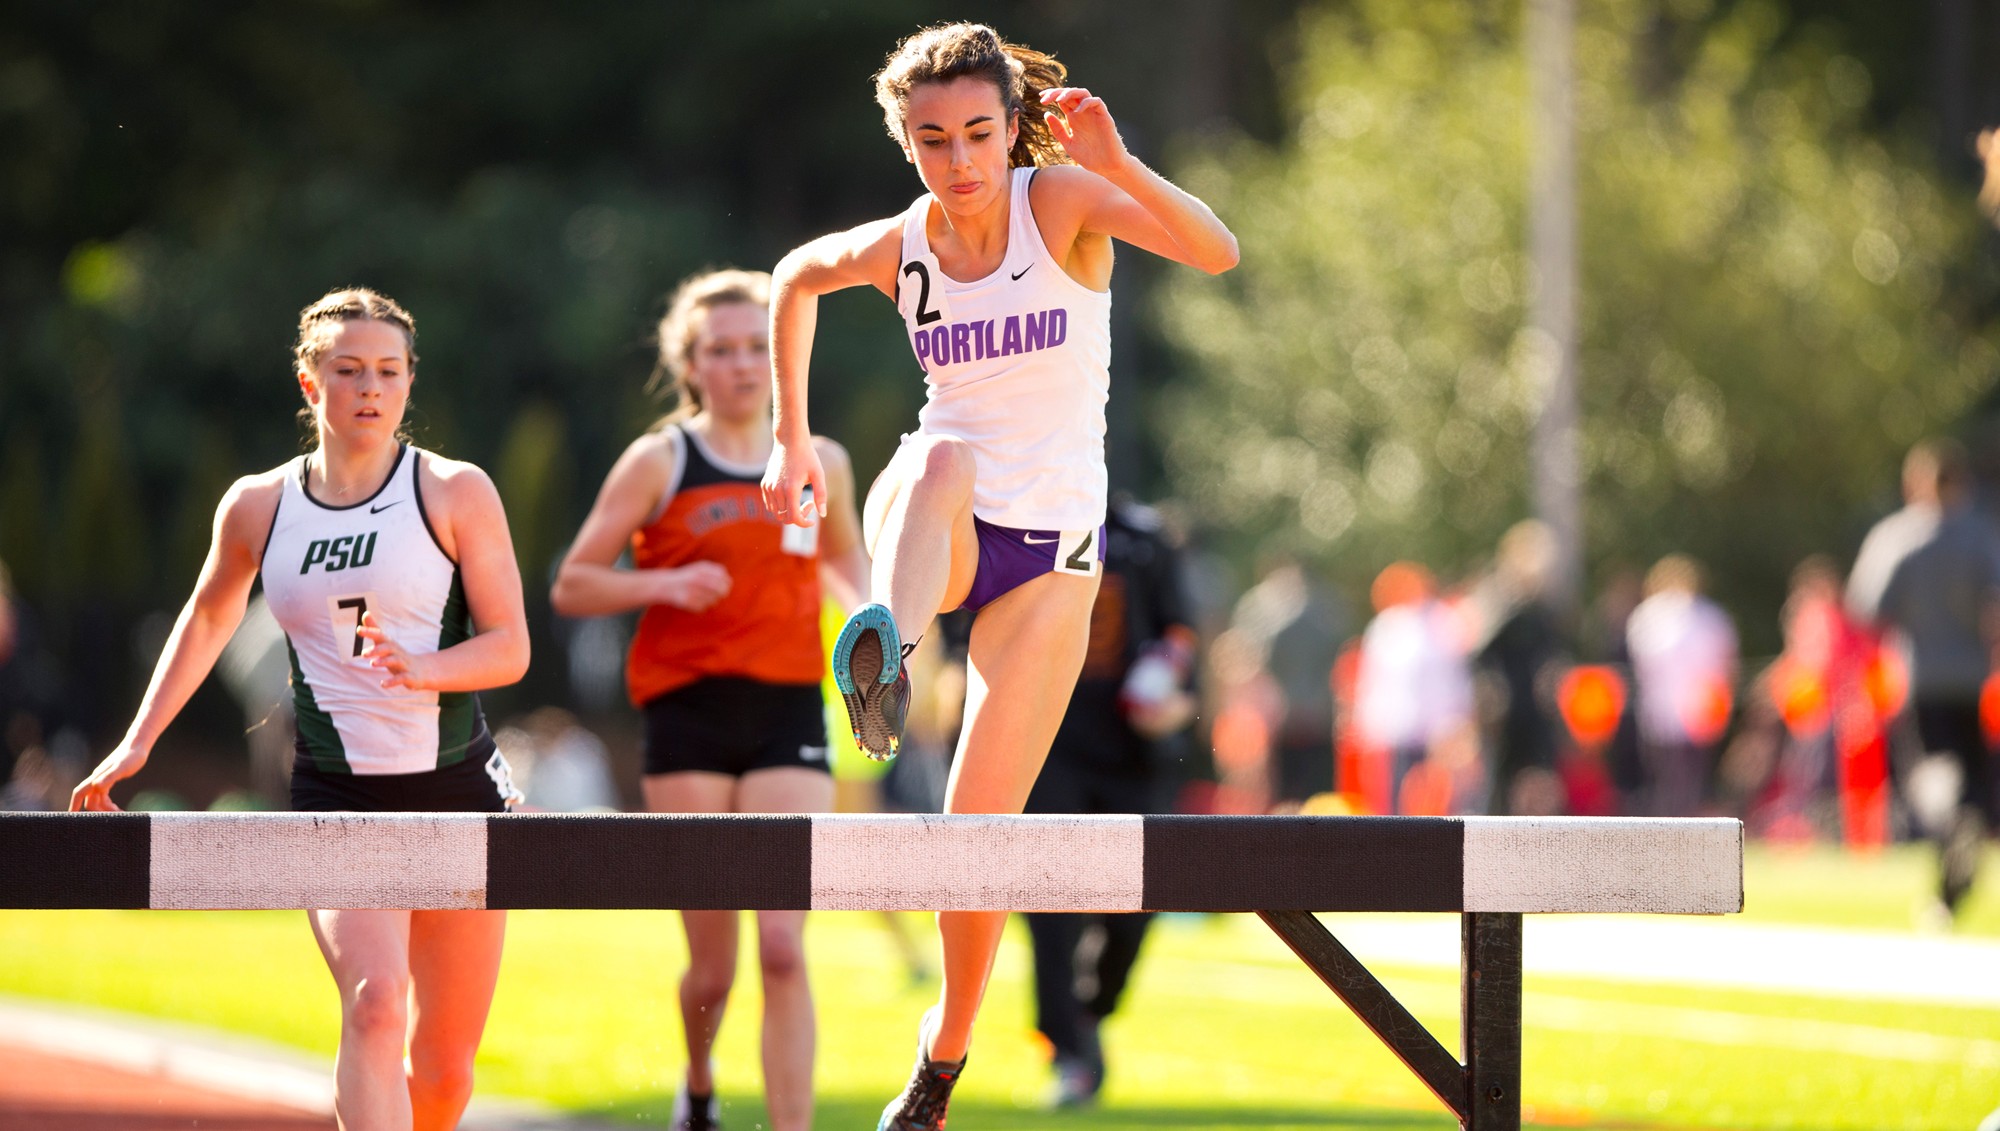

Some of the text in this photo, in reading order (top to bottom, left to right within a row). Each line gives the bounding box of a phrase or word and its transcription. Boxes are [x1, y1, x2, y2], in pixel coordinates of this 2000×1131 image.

[903, 260, 942, 327] 2
[914, 308, 1068, 372] PORTLAND
[299, 530, 379, 576] PSU
[337, 597, 368, 658] 7
